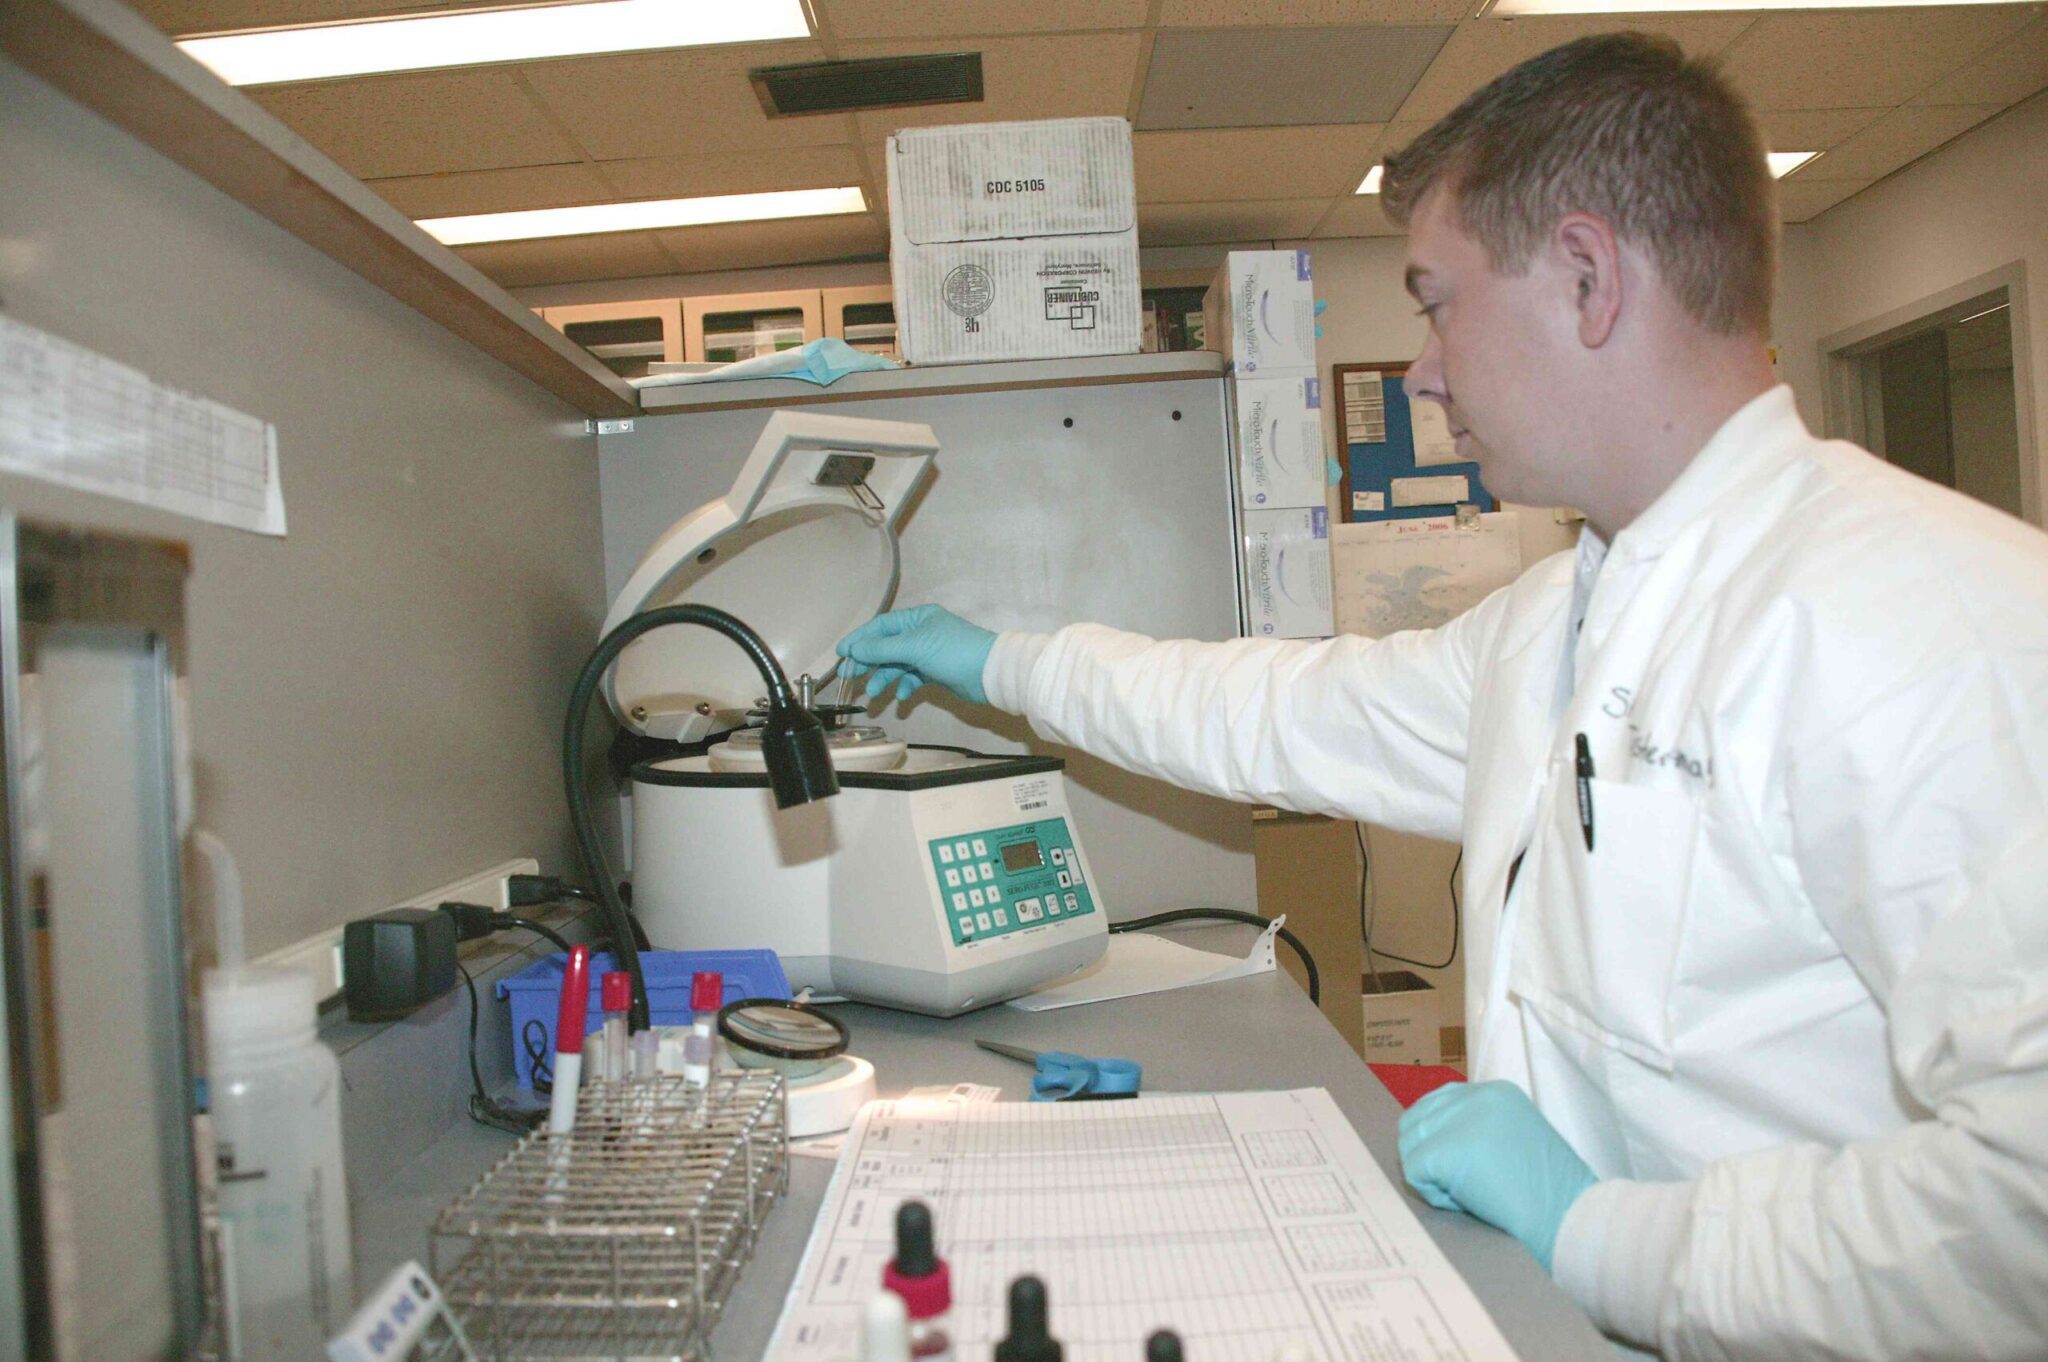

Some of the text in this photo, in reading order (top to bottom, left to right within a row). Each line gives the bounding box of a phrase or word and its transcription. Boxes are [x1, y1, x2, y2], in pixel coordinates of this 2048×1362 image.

[986, 178, 1045, 194] CDC 5105
[1047, 291, 1099, 303] CUBITAINER
